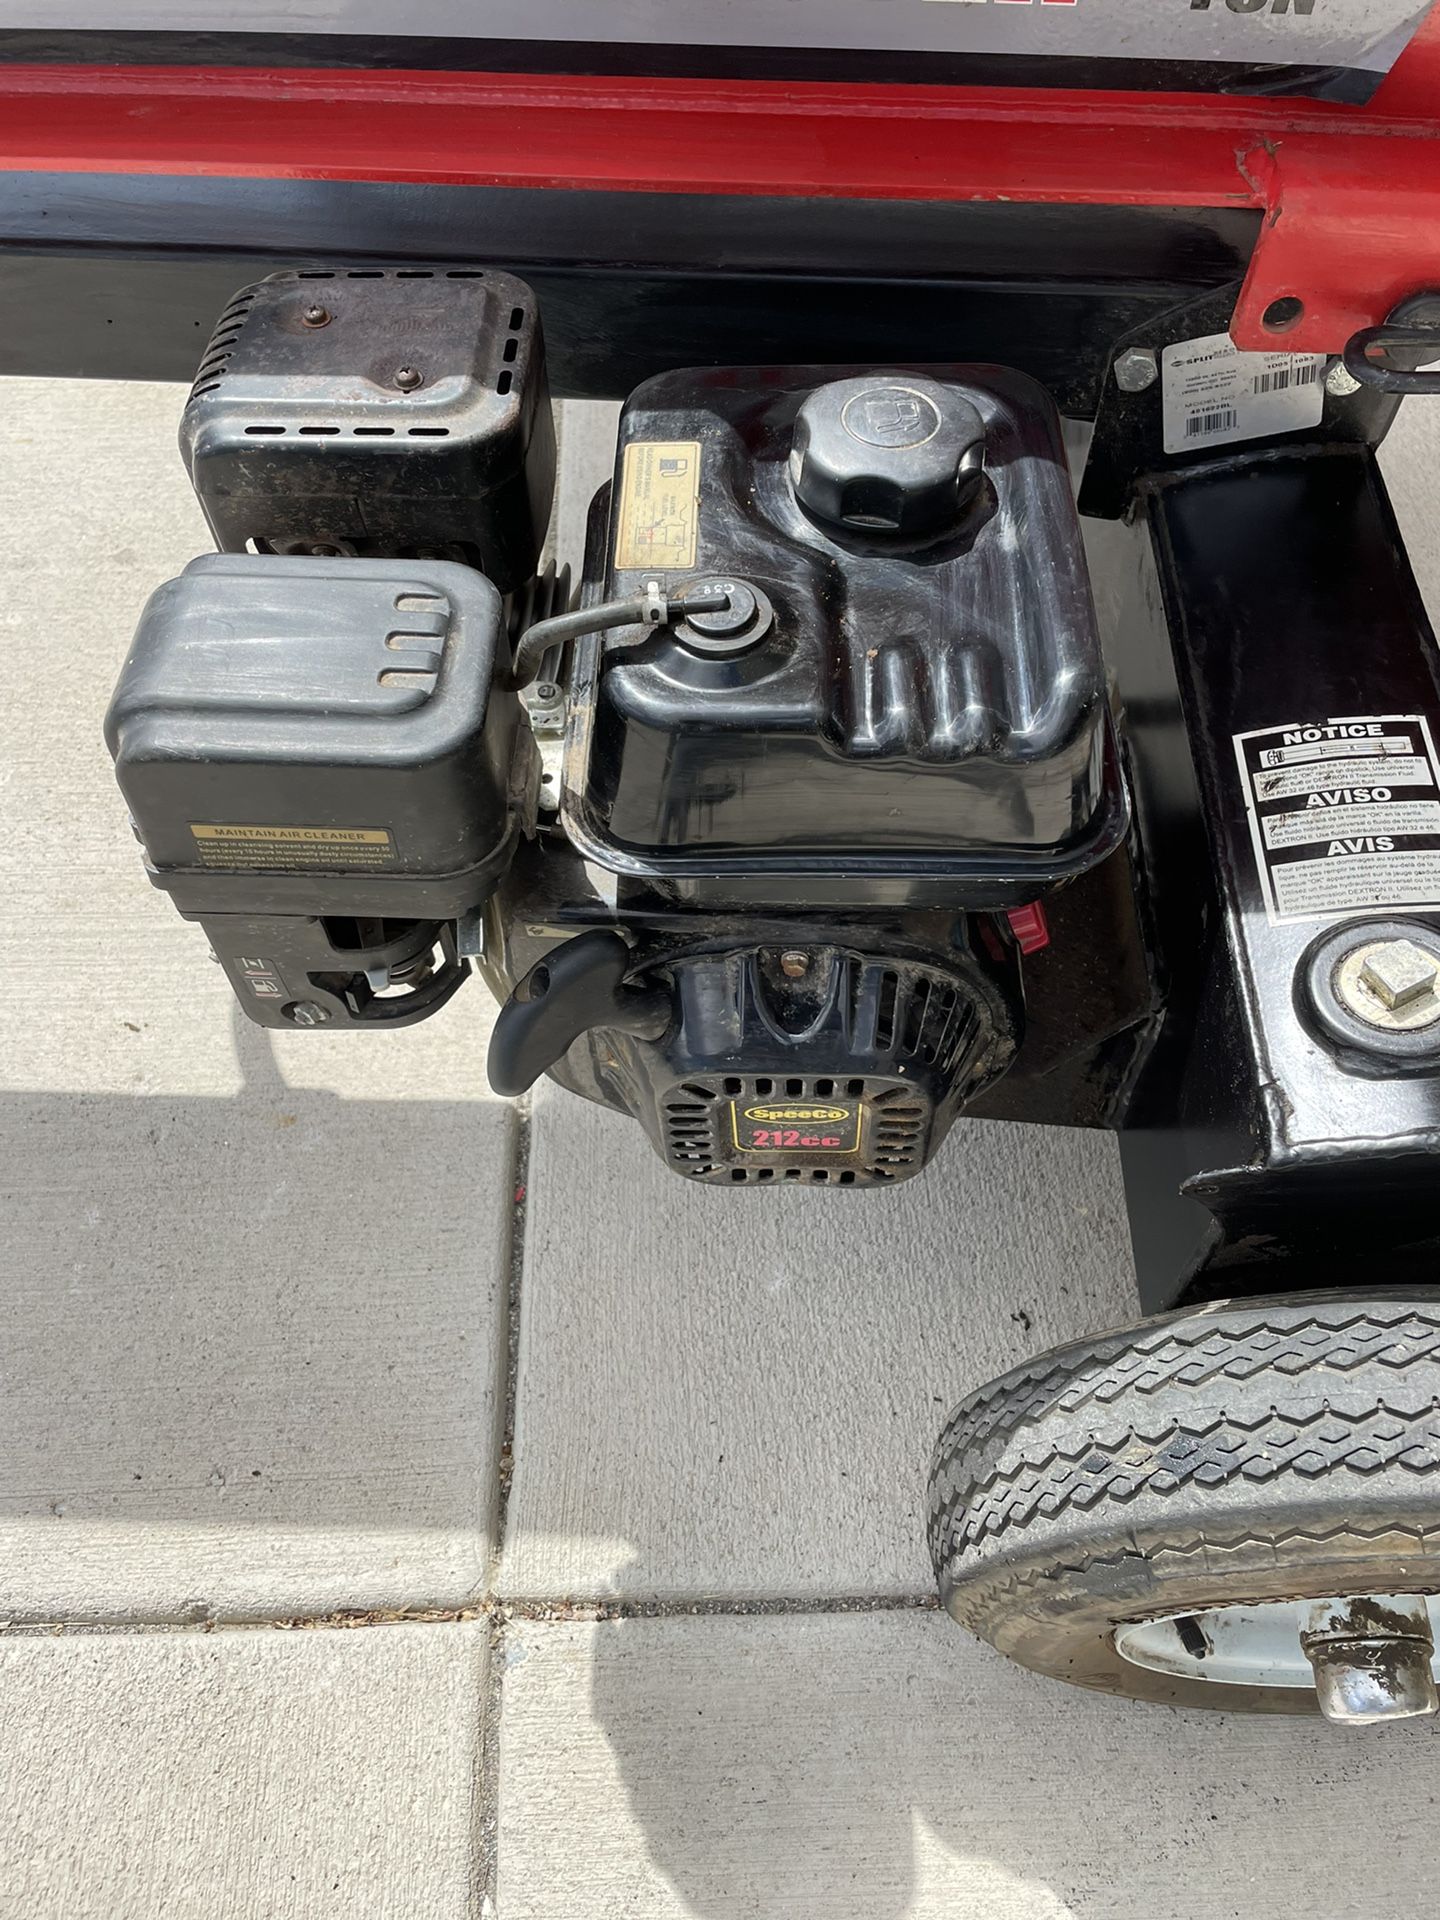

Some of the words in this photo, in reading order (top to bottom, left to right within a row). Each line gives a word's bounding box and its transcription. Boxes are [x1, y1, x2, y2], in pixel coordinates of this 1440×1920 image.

[1283, 724, 1384, 745] NOTICE
[1305, 787, 1392, 809] AVISO
[214, 829, 277, 838] MAINTAIN
[303, 831, 366, 841] CLEANER
[1327, 836, 1394, 856] AVIS
[753, 1109, 842, 1120] SpeeCo
[752, 1130, 841, 1147] 212cc
